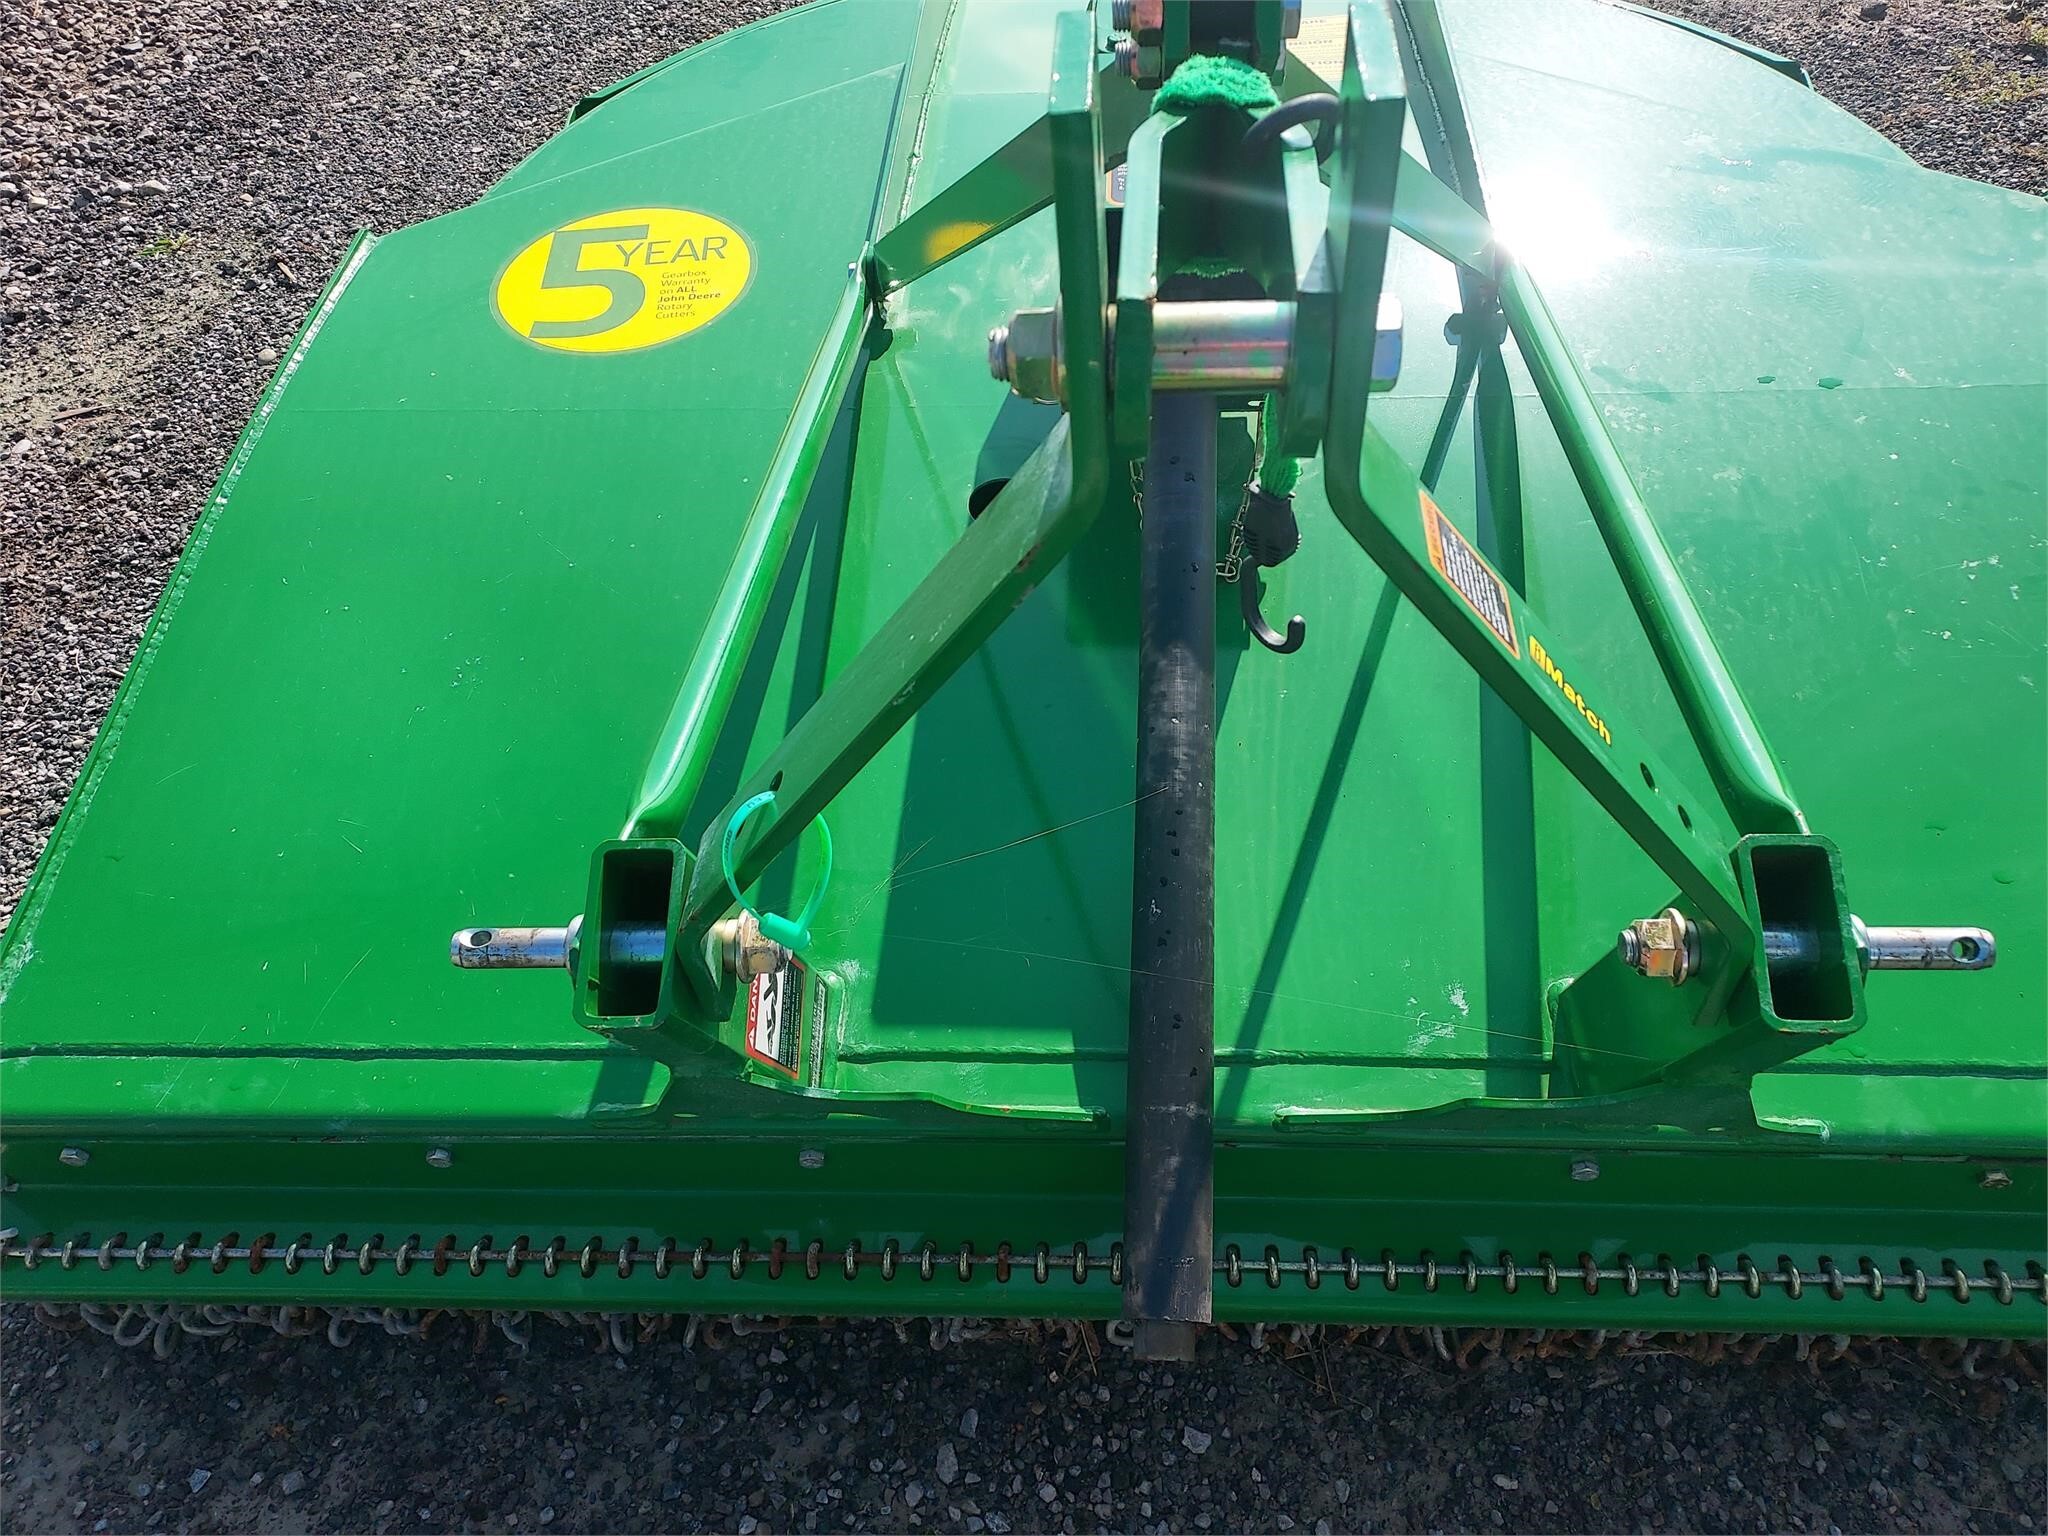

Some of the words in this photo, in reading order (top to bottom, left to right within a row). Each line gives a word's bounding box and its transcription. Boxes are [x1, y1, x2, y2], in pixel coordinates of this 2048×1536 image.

[662, 270, 707, 278] Gearbox
[529, 224, 650, 338] 5
[616, 236, 728, 267] YEAR
[661, 278, 711, 287] Warranty
[676, 285, 698, 293] ALL
[658, 295, 685, 303] John
[688, 292, 721, 301] Deere
[657, 303, 693, 311] Rotary
[655, 311, 696, 320] Cutters
